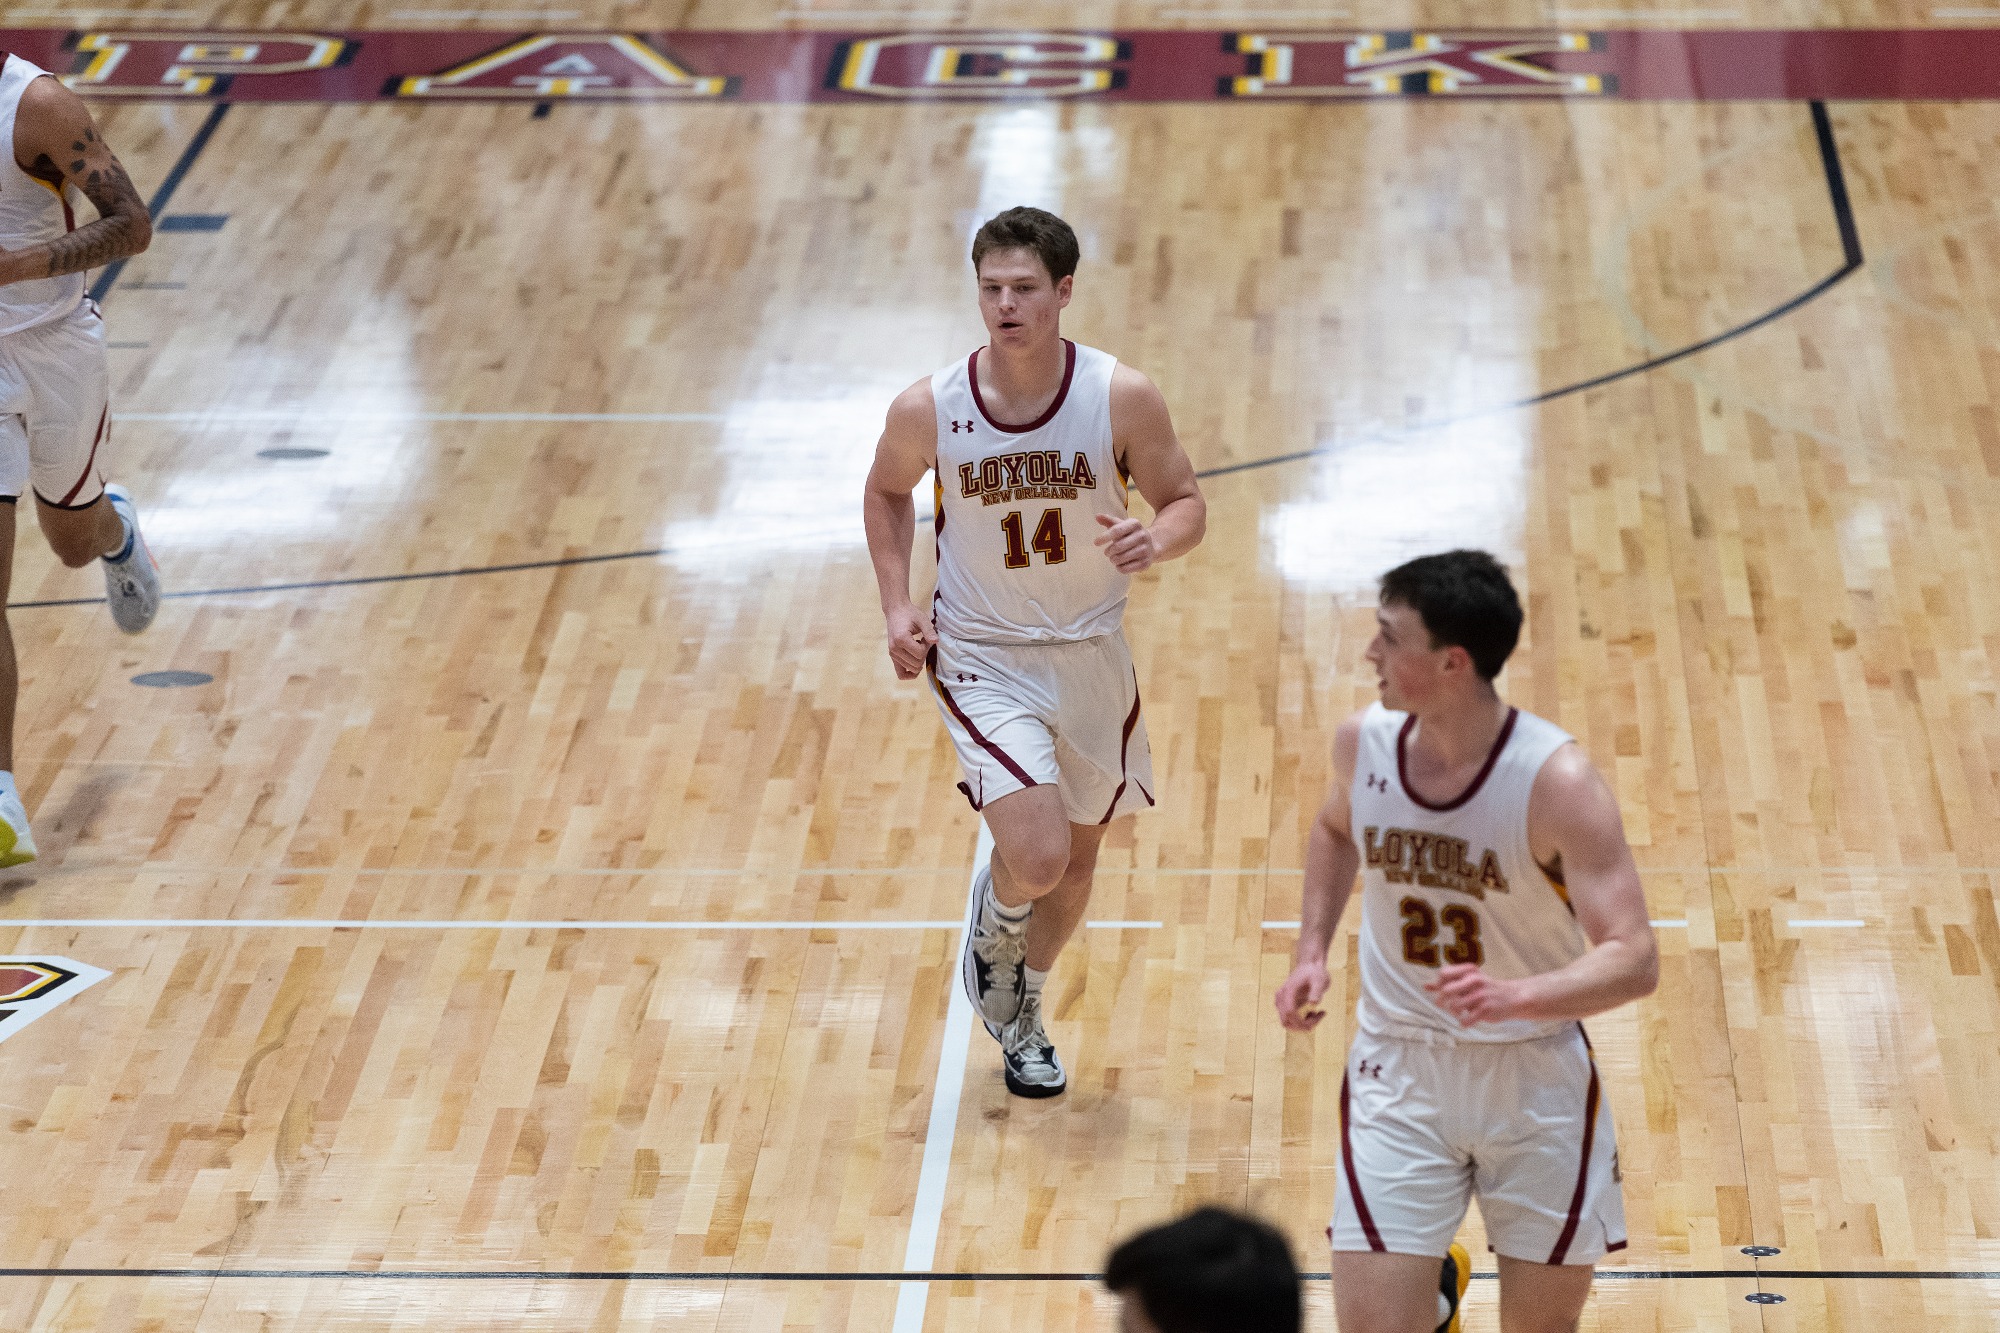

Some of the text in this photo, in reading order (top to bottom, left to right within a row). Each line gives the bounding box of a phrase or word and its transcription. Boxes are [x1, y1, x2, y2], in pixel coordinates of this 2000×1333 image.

[60, 30, 1620, 98] PACK
[959, 451, 1096, 498] LOYOLA
[981, 486, 1078, 507] NEW ORLEANS
[1001, 508, 1066, 569] 14
[1364, 826, 1509, 894] LOYOLA
[1400, 896, 1485, 968] 23
